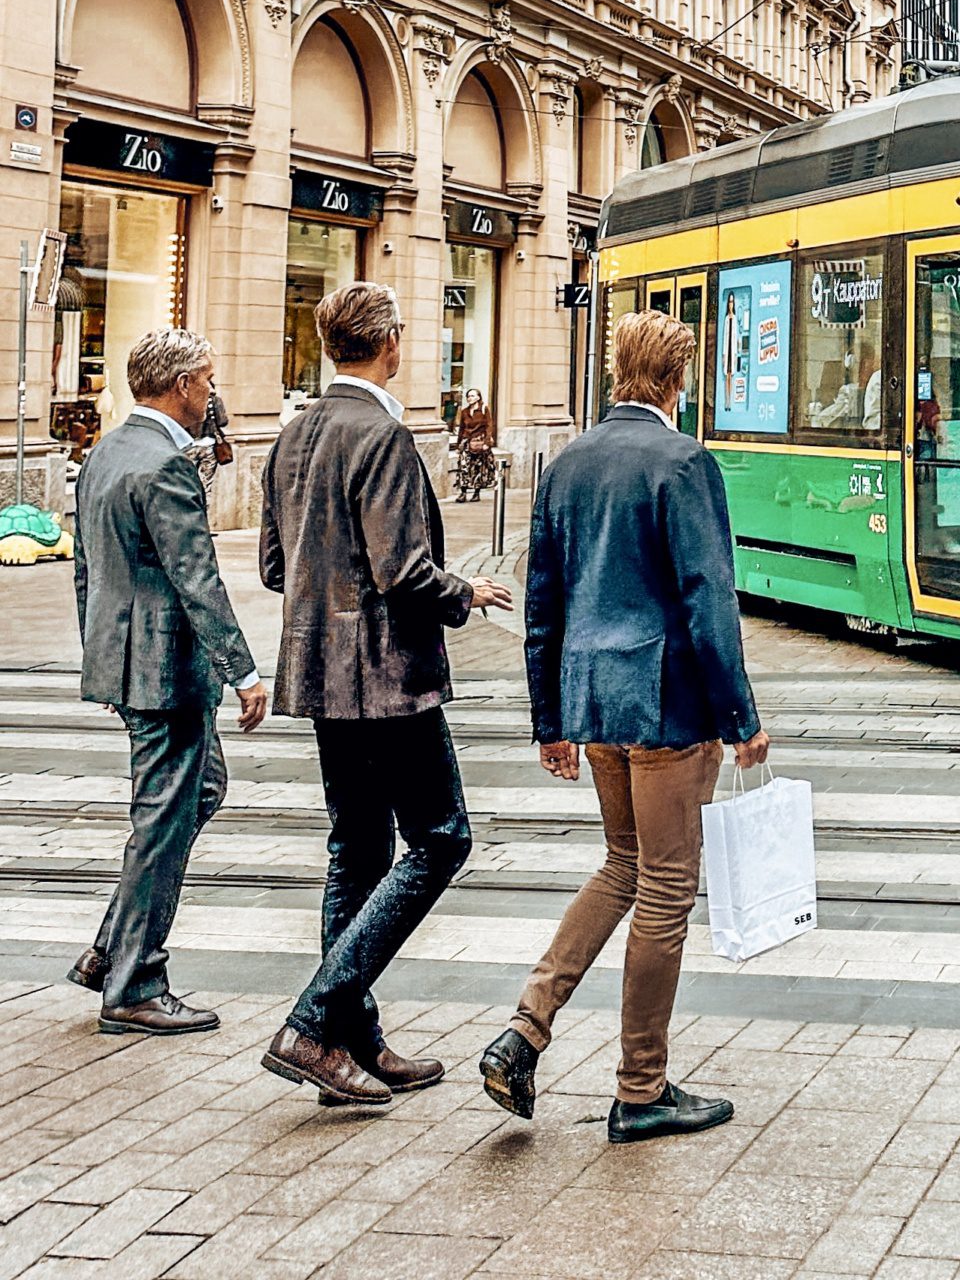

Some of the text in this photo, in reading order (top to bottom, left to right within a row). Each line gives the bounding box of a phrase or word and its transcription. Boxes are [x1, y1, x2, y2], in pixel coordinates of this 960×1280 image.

[122, 133, 162, 172] Zio
[322, 180, 349, 211] Zio
[472, 208, 493, 234] Zio
[833, 272, 883, 307] Kauppatori
[868, 513, 887, 534] 453
[794, 912, 812, 925] SEB
